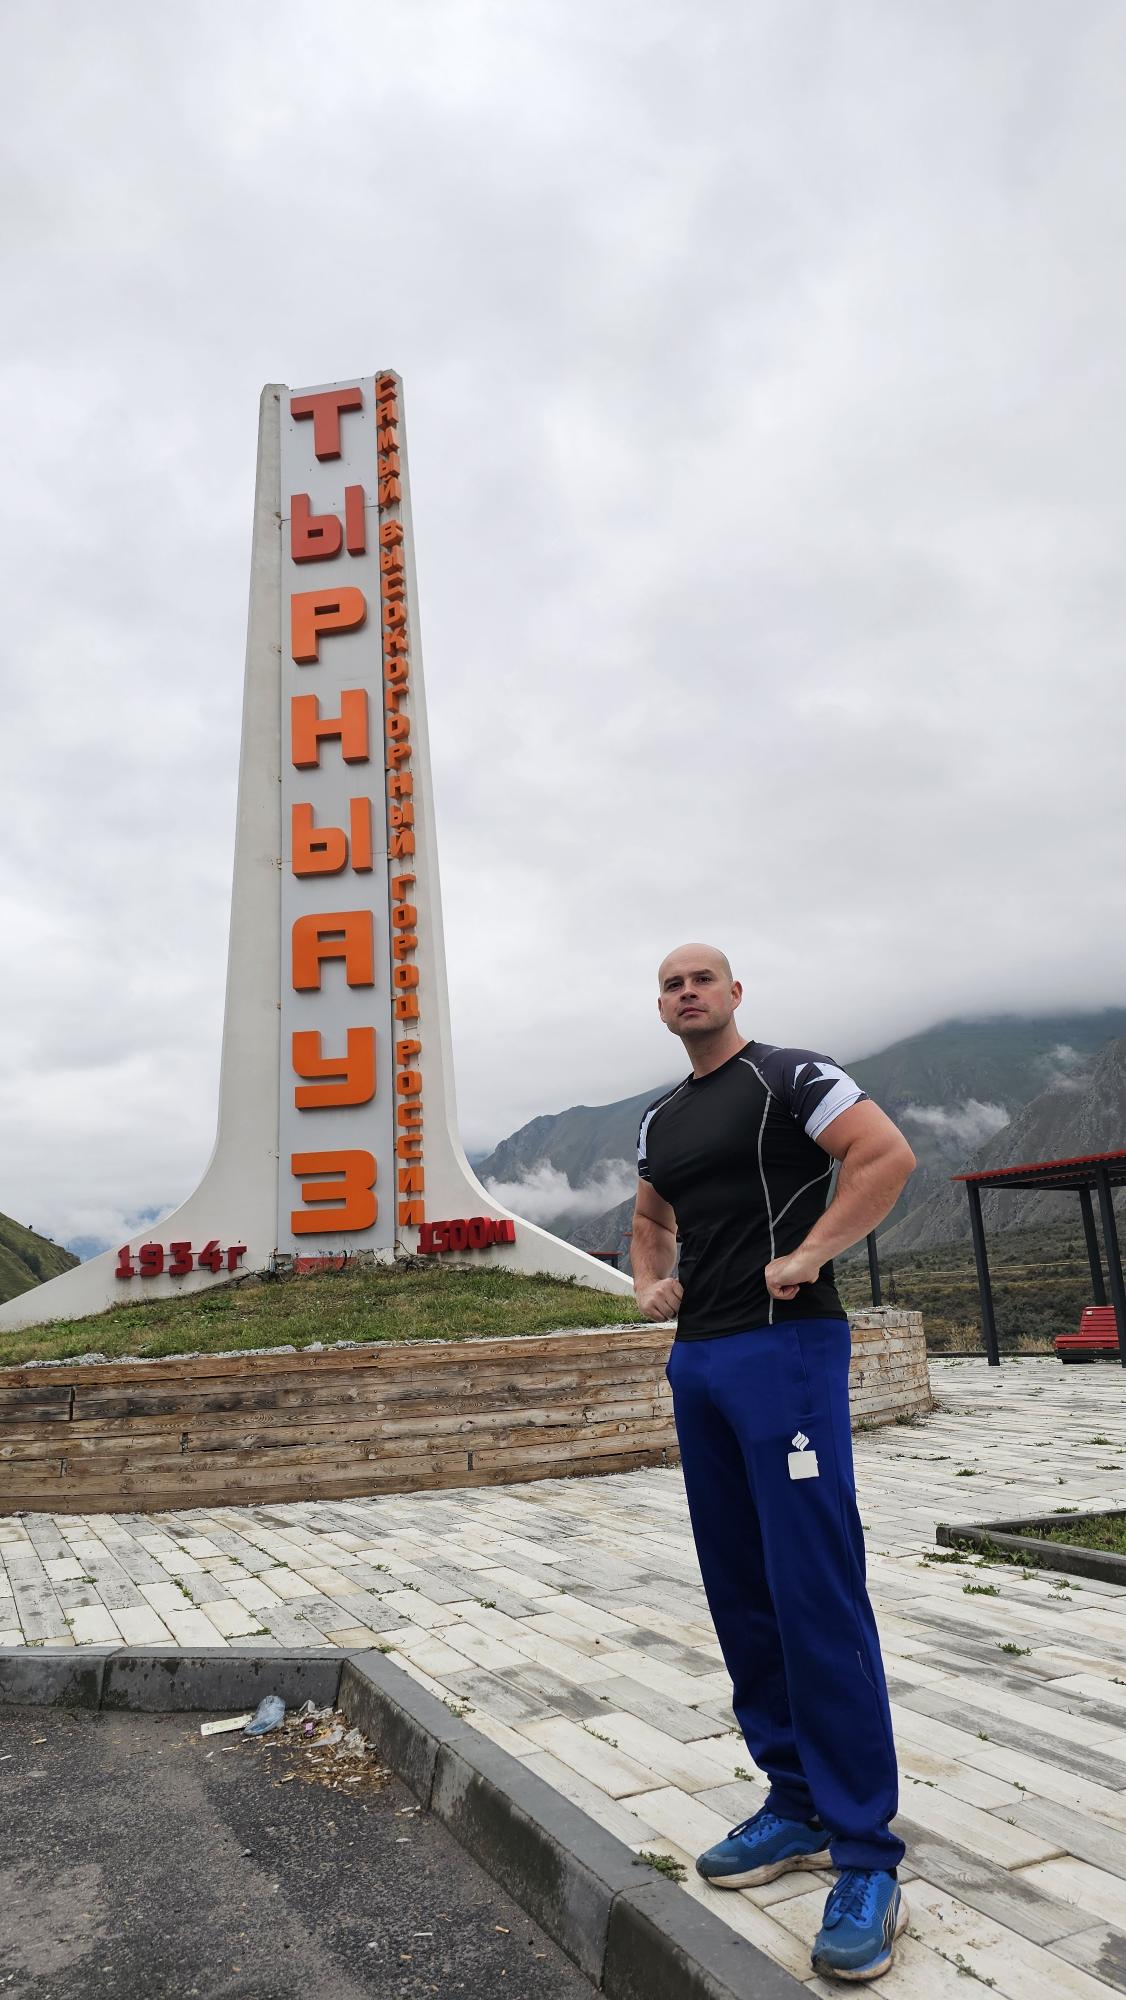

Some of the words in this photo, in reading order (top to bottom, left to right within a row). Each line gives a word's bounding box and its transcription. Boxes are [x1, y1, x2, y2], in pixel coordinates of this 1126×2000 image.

[375, 375, 401, 509] САМЫЙ
[379, 519, 416, 860] ВЫСОКОГОРНЫЙ
[290, 387, 378, 1236] ТЫРНЫАУЗ
[392, 874, 420, 1021] ГОРОД
[396, 1039, 425, 1226] РОССИИ
